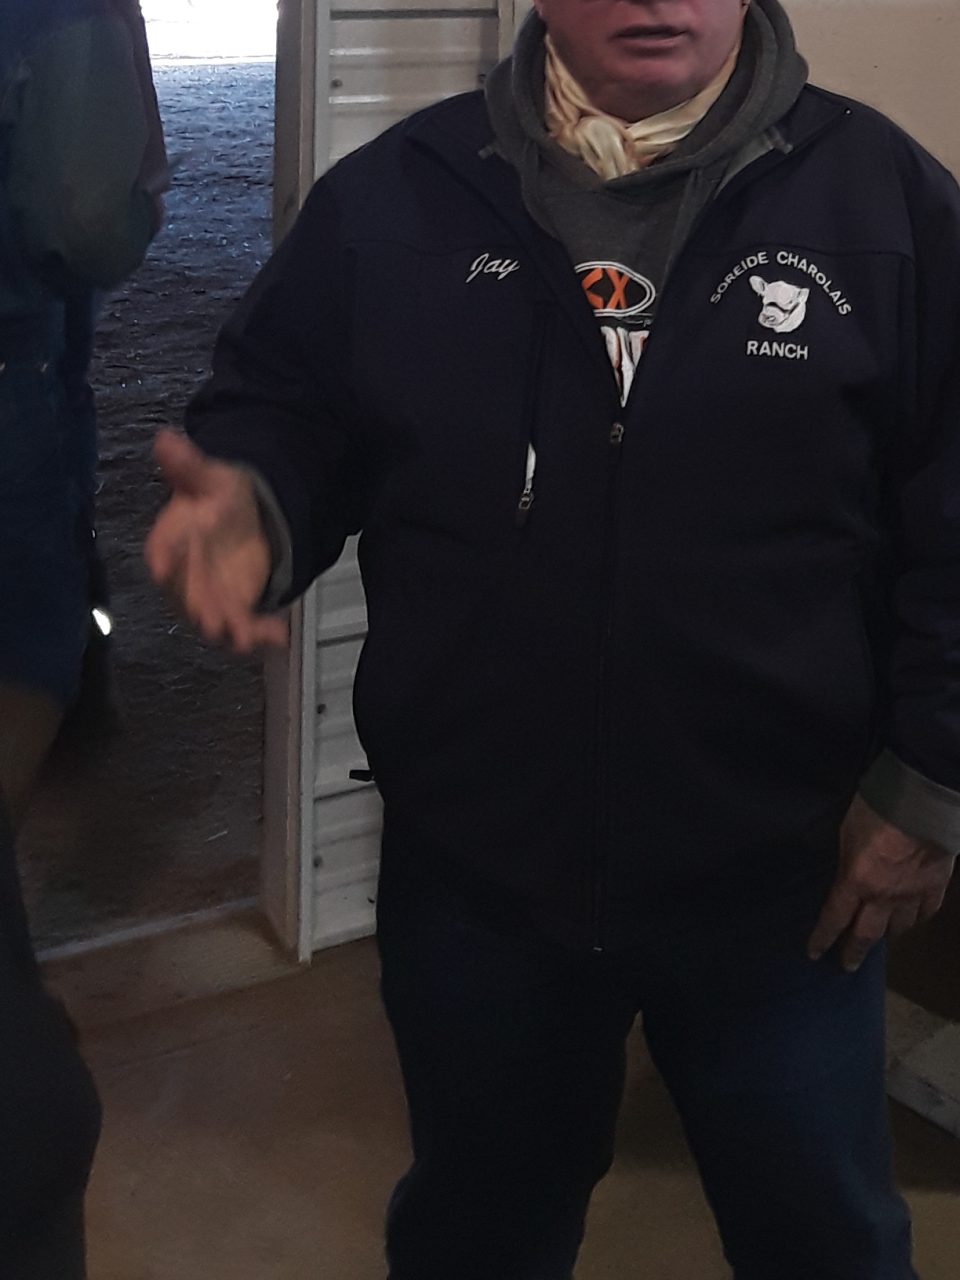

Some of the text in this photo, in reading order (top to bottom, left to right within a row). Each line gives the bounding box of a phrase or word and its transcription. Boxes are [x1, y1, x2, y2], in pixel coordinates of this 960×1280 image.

[465, 252, 520, 284] Jay
[710, 250, 852, 316] SOREIDE CHAROLAIS
[746, 340, 809, 360] RANCH
